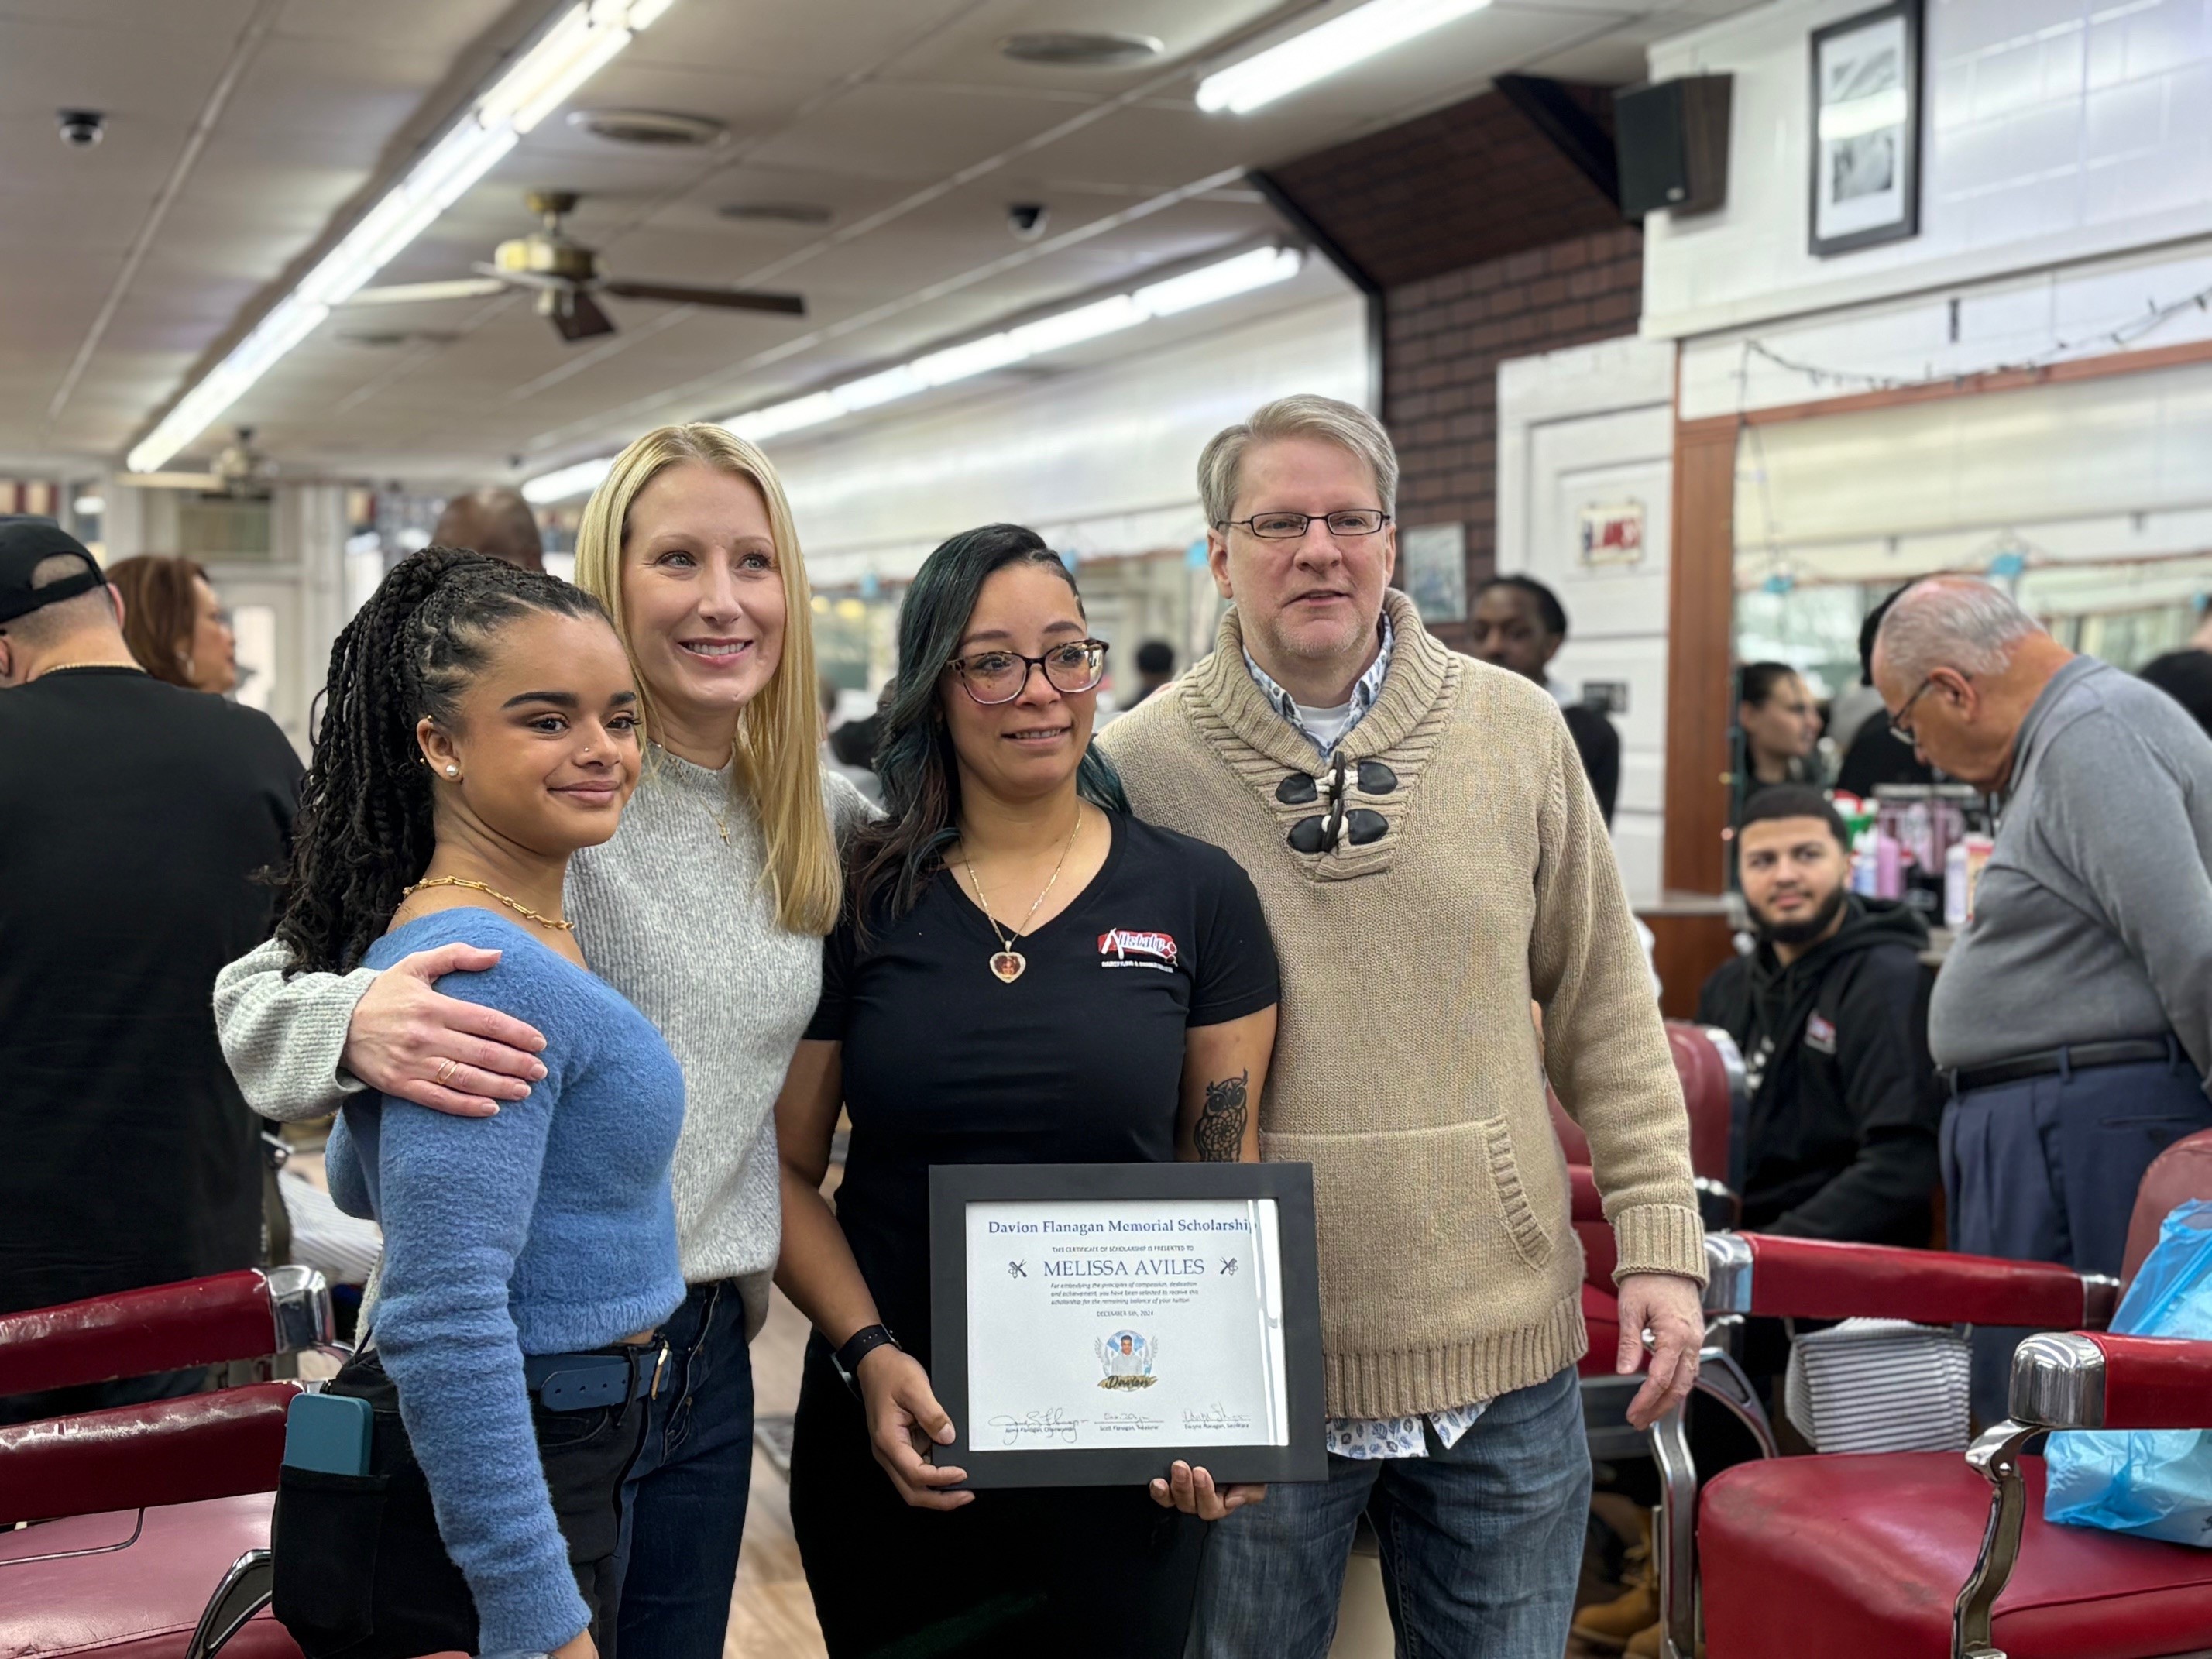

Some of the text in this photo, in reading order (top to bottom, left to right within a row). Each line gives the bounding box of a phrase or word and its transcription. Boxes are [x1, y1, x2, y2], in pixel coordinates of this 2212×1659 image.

[1101, 929, 1166, 960] Allstate
[988, 1221, 1038, 1233] Davion
[1042, 1221, 1104, 1236] Flanagan
[1108, 1220, 1173, 1232] Memorial
[1044, 1259, 1205, 1276] MELISSA AVILES
